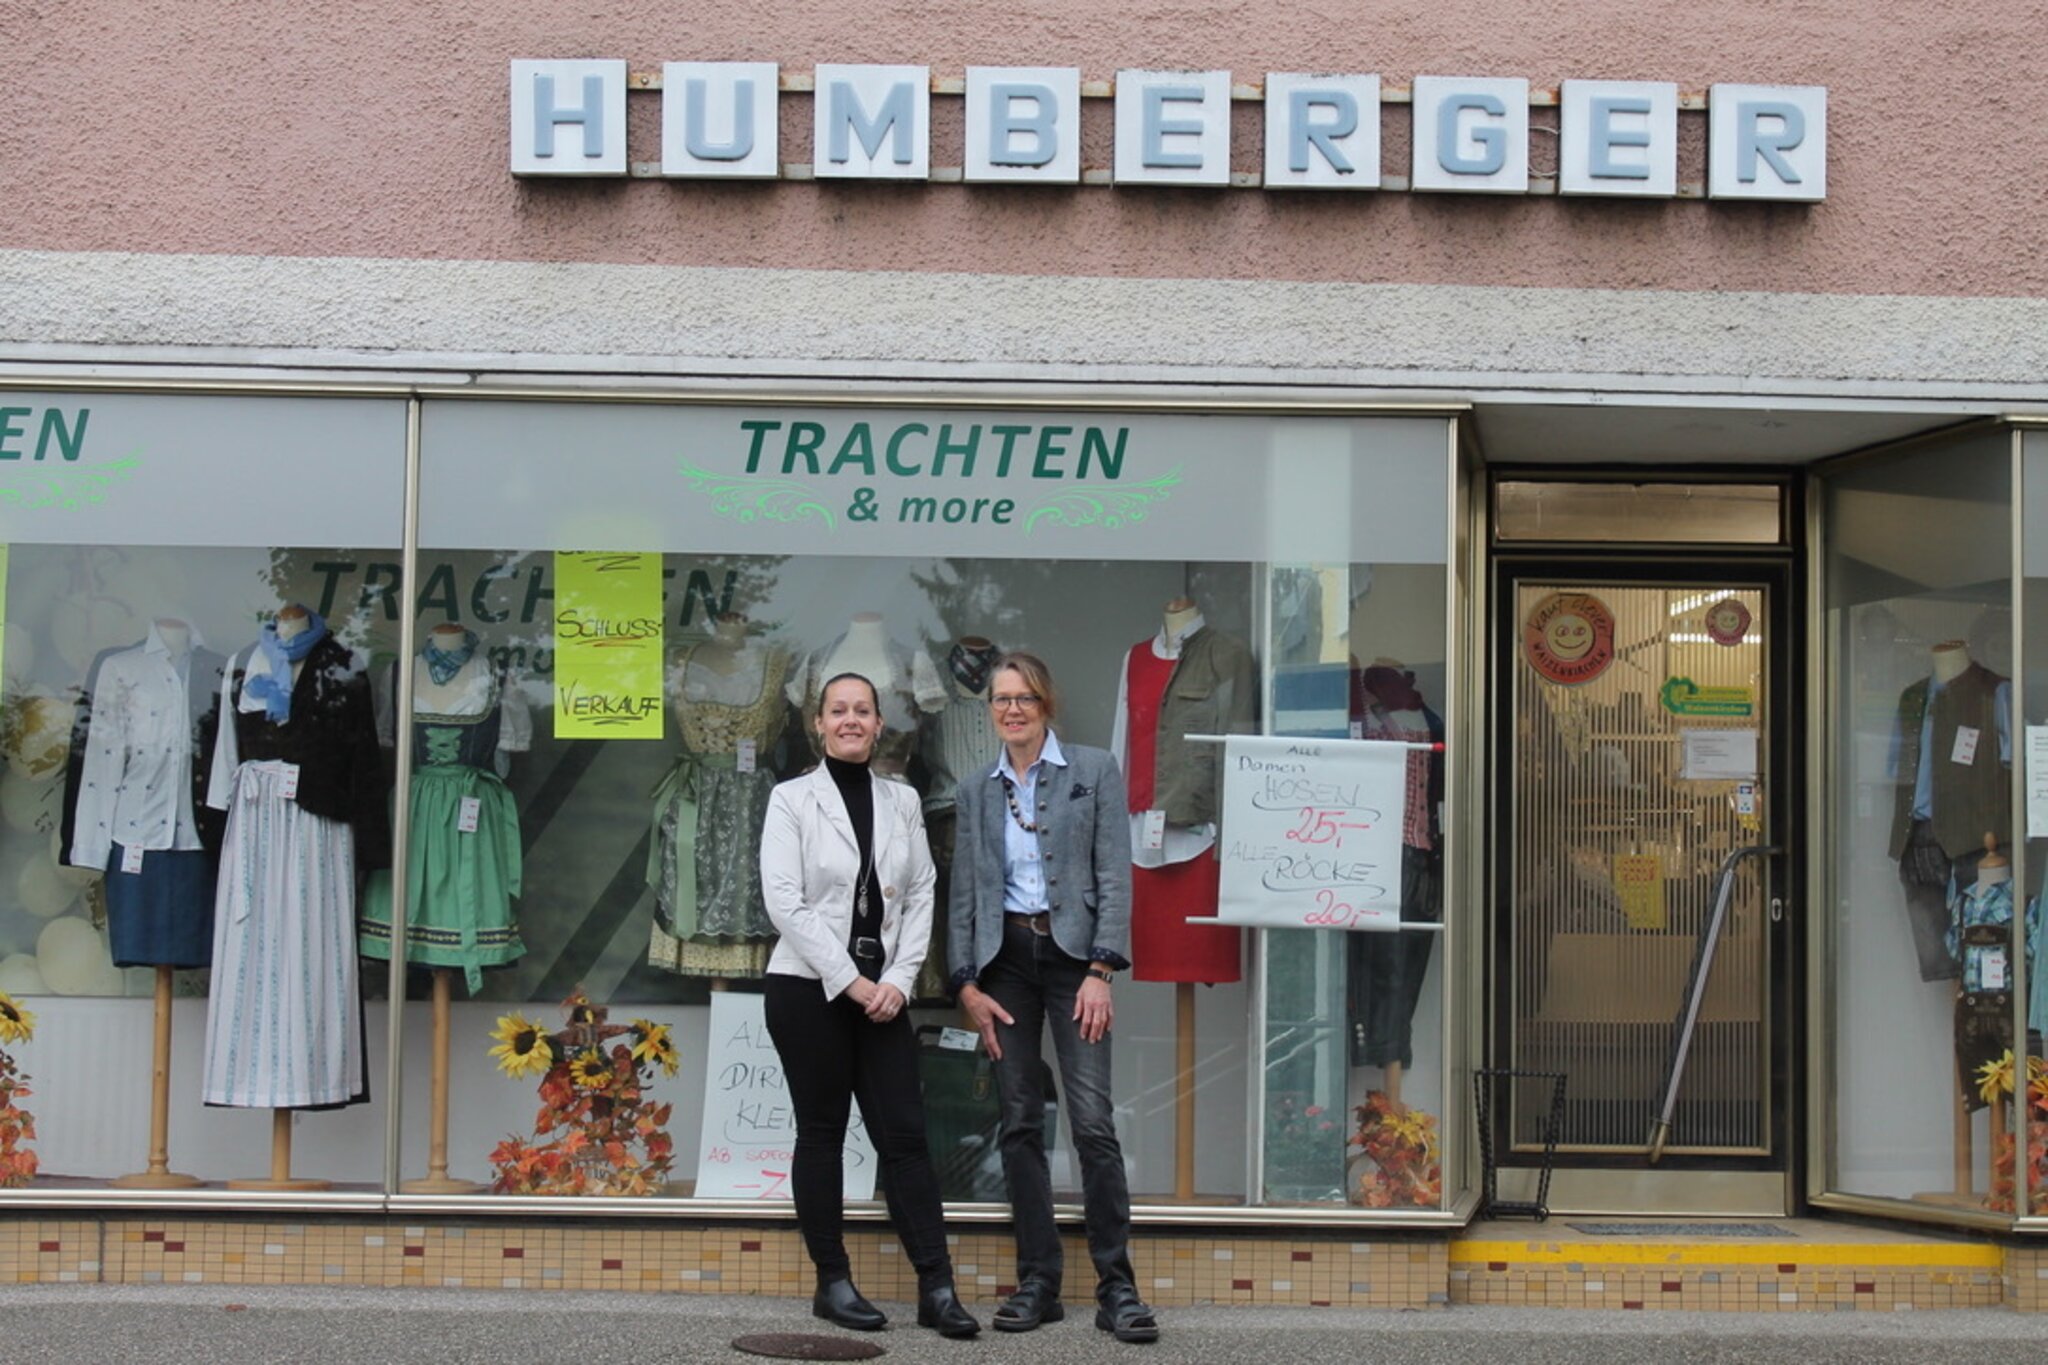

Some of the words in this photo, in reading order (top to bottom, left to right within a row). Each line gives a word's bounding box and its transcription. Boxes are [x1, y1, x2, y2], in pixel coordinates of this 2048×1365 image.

[533, 74, 1805, 183] HUMBERGER
[740, 420, 1130, 480] TRACHTEN
[846, 487, 880, 522] &
[897, 495, 1016, 525] more
[560, 679, 661, 717] VERKAUF
[1238, 755, 1306, 774] Damen
[1265, 775, 1360, 807] HOSEN
[1226, 841, 1278, 862] ALLE
